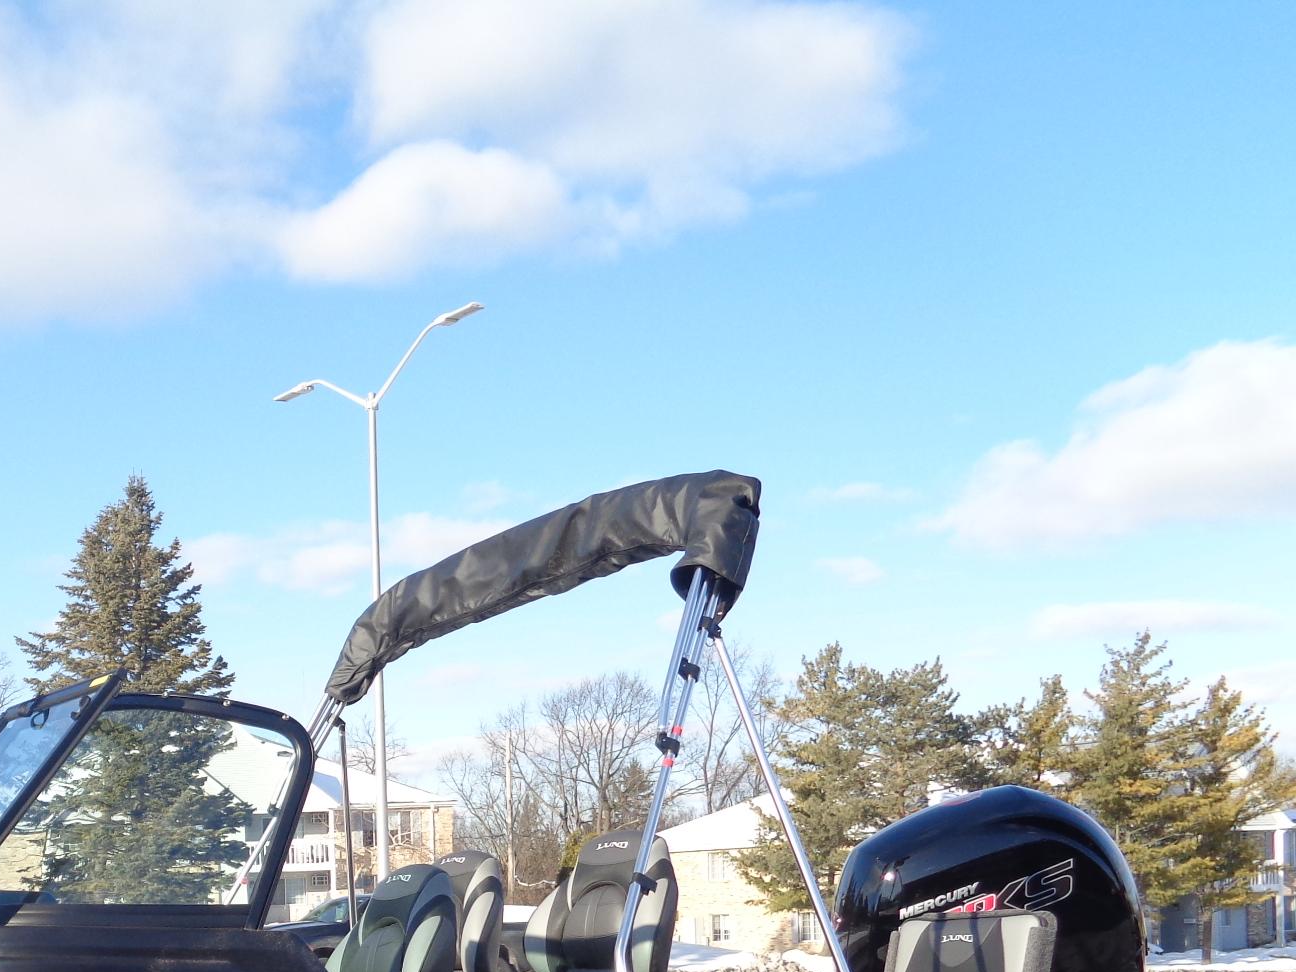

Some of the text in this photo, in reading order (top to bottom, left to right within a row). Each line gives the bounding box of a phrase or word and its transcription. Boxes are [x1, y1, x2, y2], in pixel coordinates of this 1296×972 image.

[596, 841, 628, 850] LUND
[899, 881, 979, 920] MERCURY
[941, 934, 973, 943] LUND
